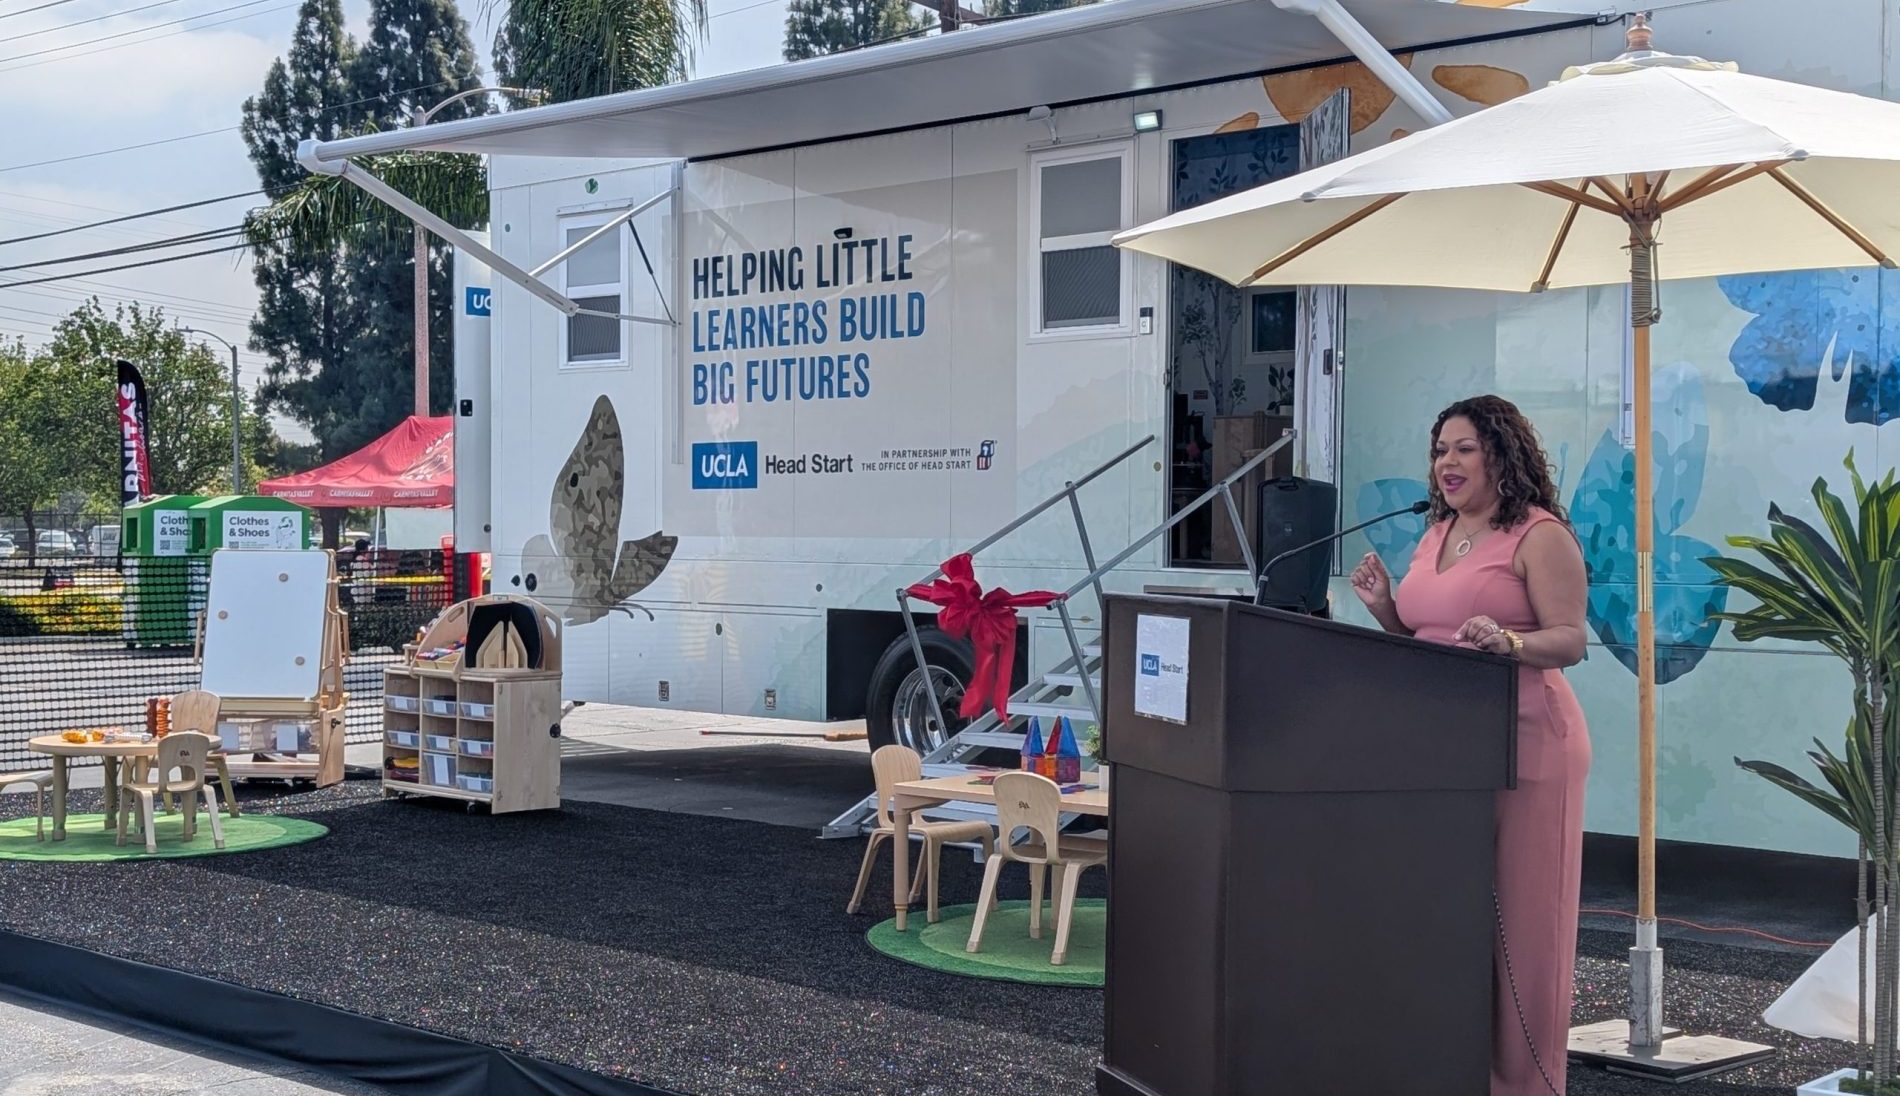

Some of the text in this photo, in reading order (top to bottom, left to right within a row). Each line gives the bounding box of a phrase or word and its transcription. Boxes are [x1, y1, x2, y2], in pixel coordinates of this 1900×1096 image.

[693, 234, 913, 300] HELPING LITTLE
[693, 291, 925, 353] LEARNERS BUILD
[693, 353, 870, 405] BIG FUTURES
[880, 448, 971, 459] IN PARTNERSHIP WITH
[701, 453, 853, 478] UCLA Head Start
[861, 460, 971, 471] THE OFFICE OF HEAD START
[229, 516, 269, 526] Clothes
[160, 527, 168, 536] &
[229, 528, 270, 537] & Shoes
[1143, 659, 1157, 671] UCLA
